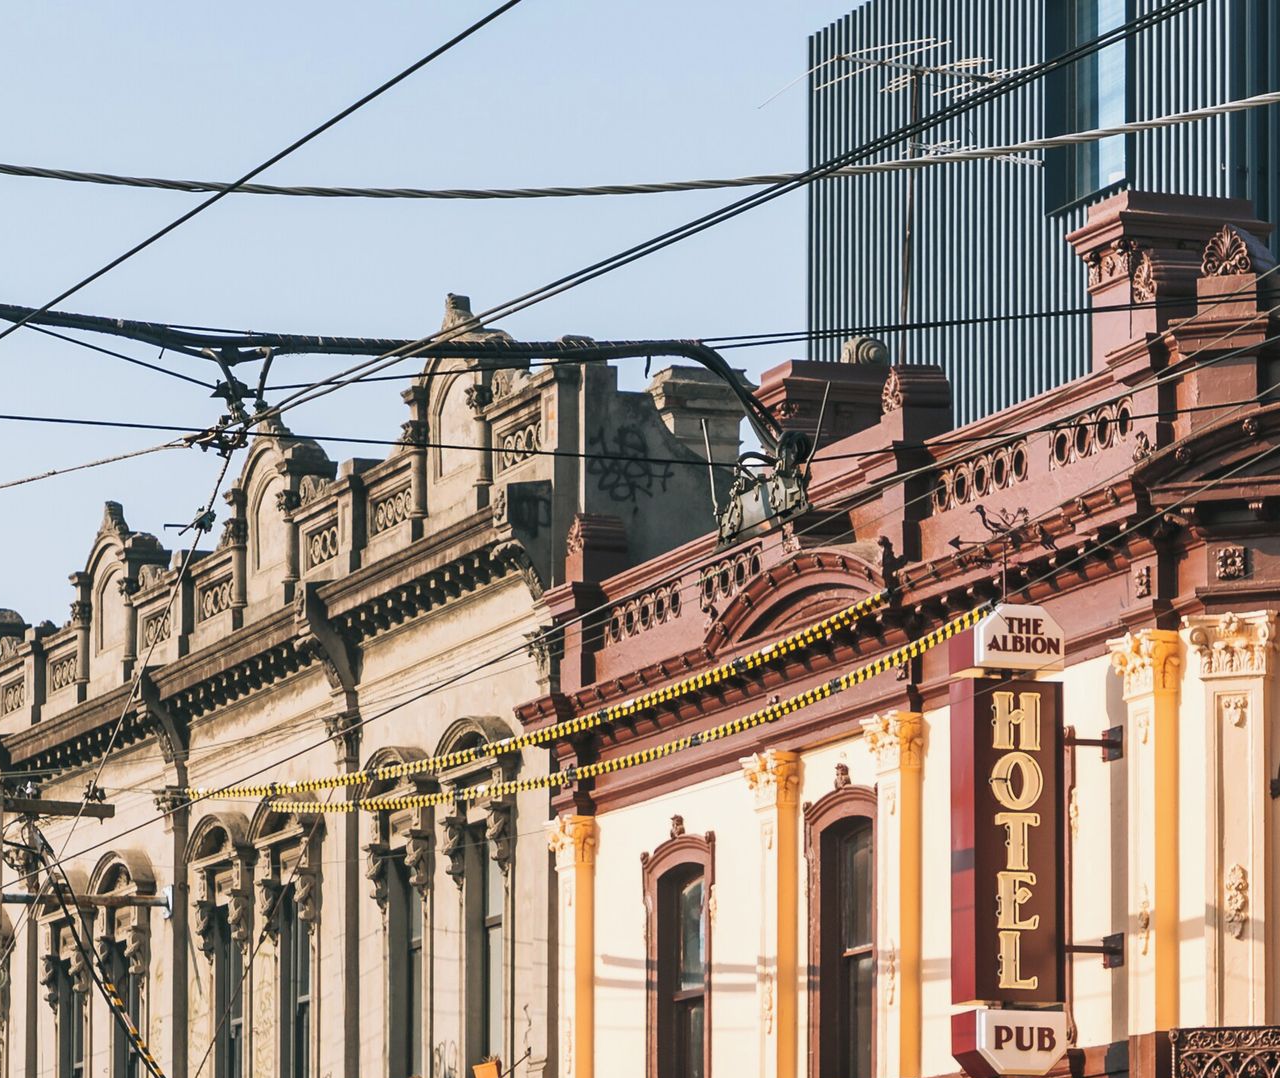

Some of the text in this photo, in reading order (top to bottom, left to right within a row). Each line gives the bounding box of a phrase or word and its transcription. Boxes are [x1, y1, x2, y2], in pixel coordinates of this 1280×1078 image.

[1005, 616, 1045, 636] THE
[987, 634, 1061, 655] ALBION
[990, 691, 1044, 990] HOTEL
[994, 1025, 1057, 1053] PUB
